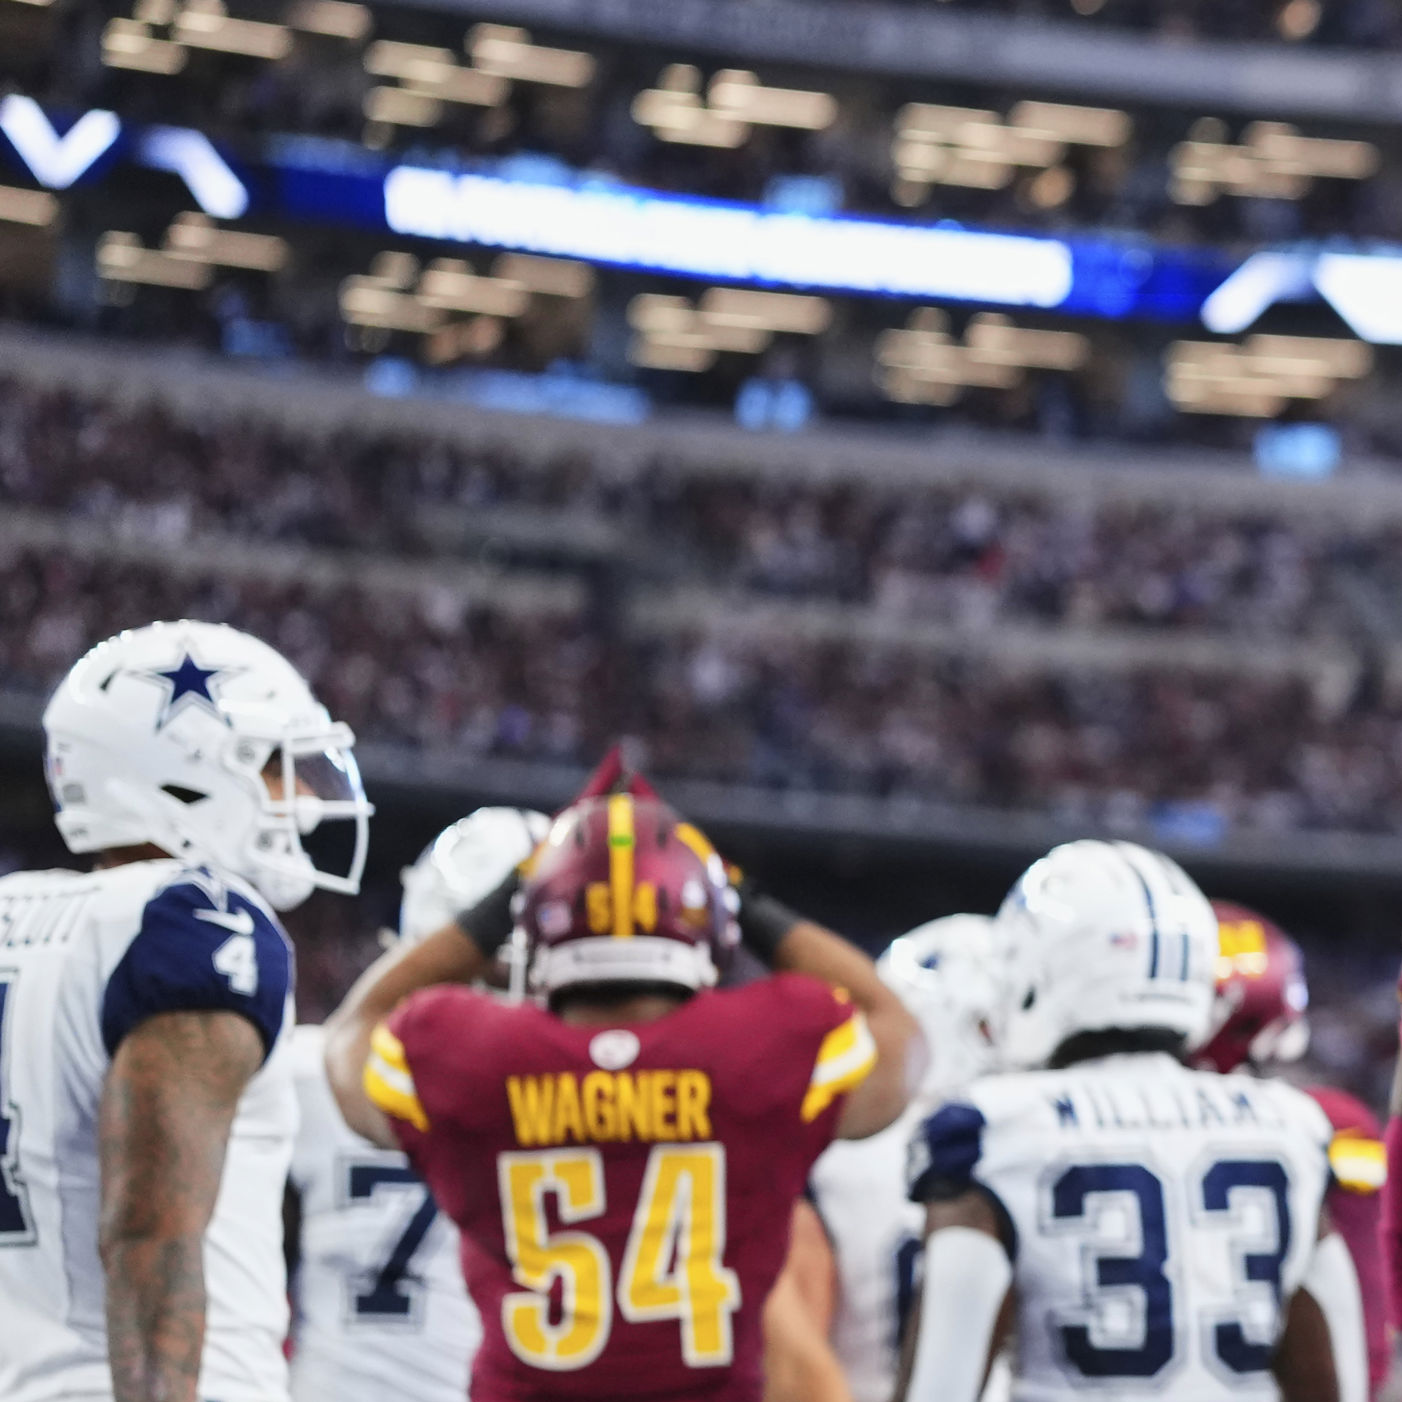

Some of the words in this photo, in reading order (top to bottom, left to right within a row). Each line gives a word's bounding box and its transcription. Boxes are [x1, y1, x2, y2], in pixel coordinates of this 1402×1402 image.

[213, 933, 258, 997] 4
[506, 1069, 713, 1147] WAGNER
[1042, 1084, 1288, 1130] WILLIAM
[497, 1143, 741, 1370] 54
[1042, 1150, 1301, 1388] 33
